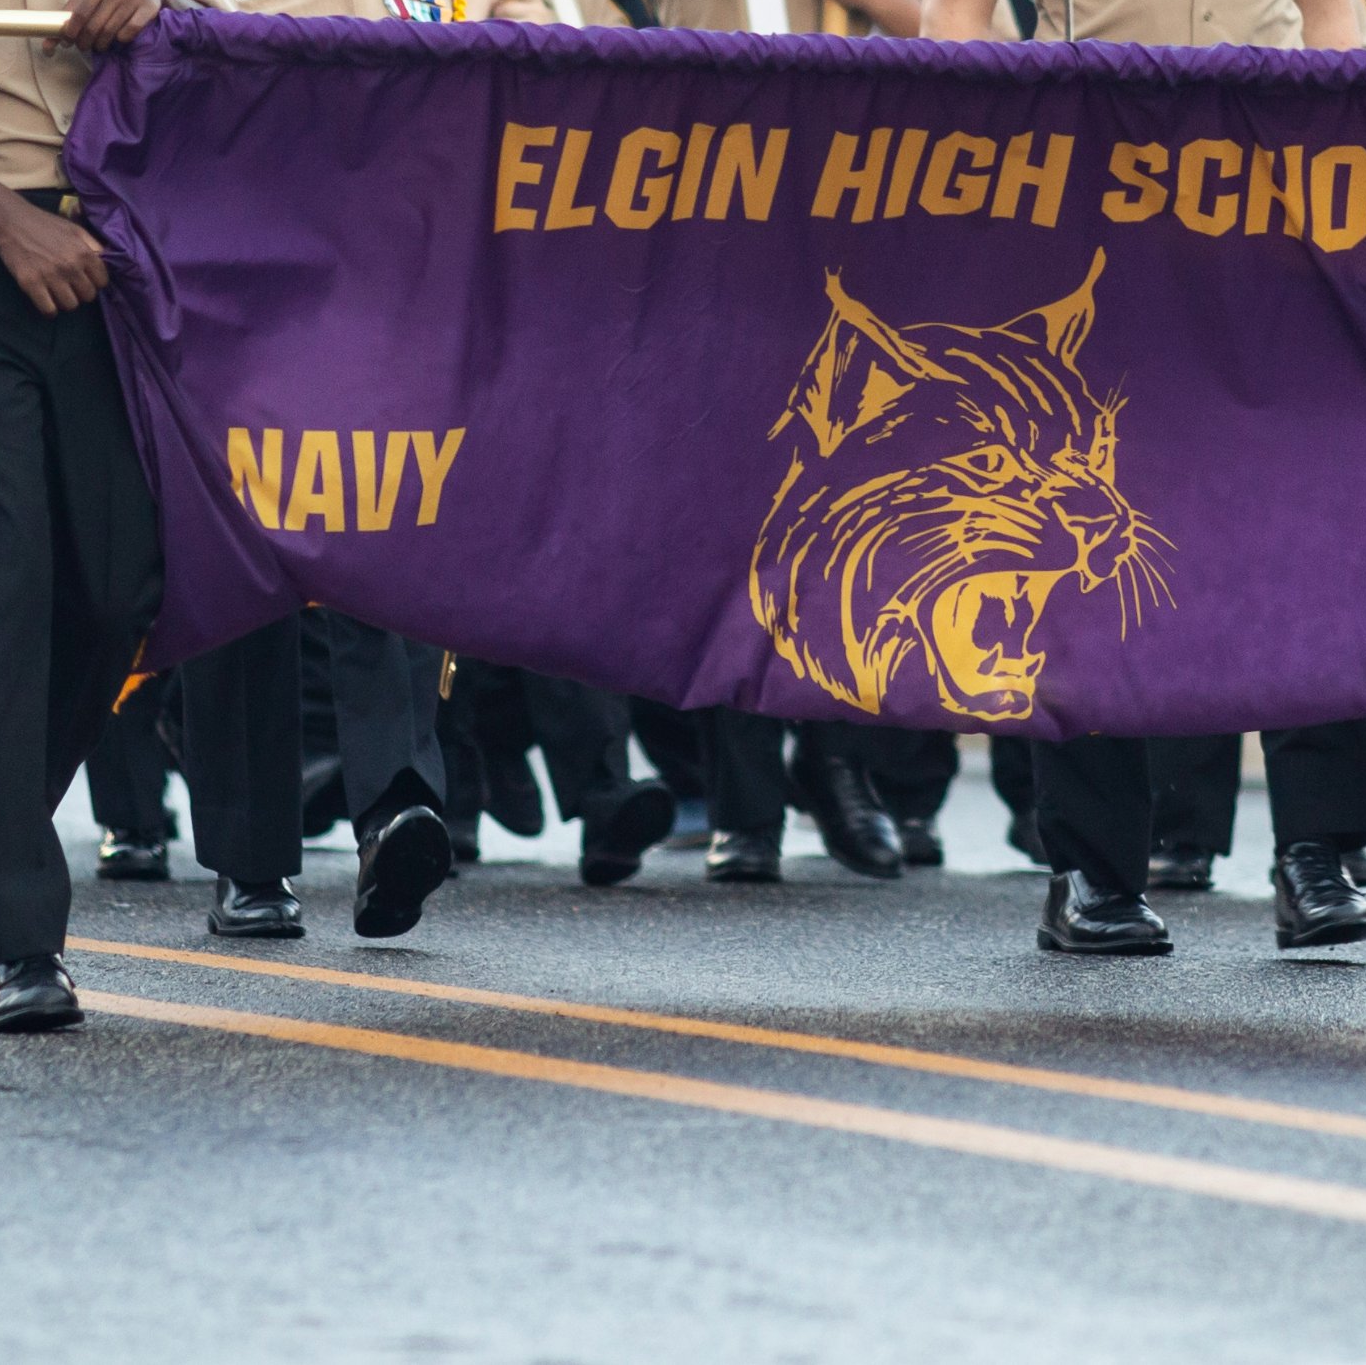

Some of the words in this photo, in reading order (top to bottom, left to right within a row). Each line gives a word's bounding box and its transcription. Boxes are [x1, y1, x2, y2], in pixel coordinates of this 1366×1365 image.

[493, 121, 791, 234] ELGIN
[809, 127, 1076, 229] HIGH
[226, 426, 467, 533] NAVY
